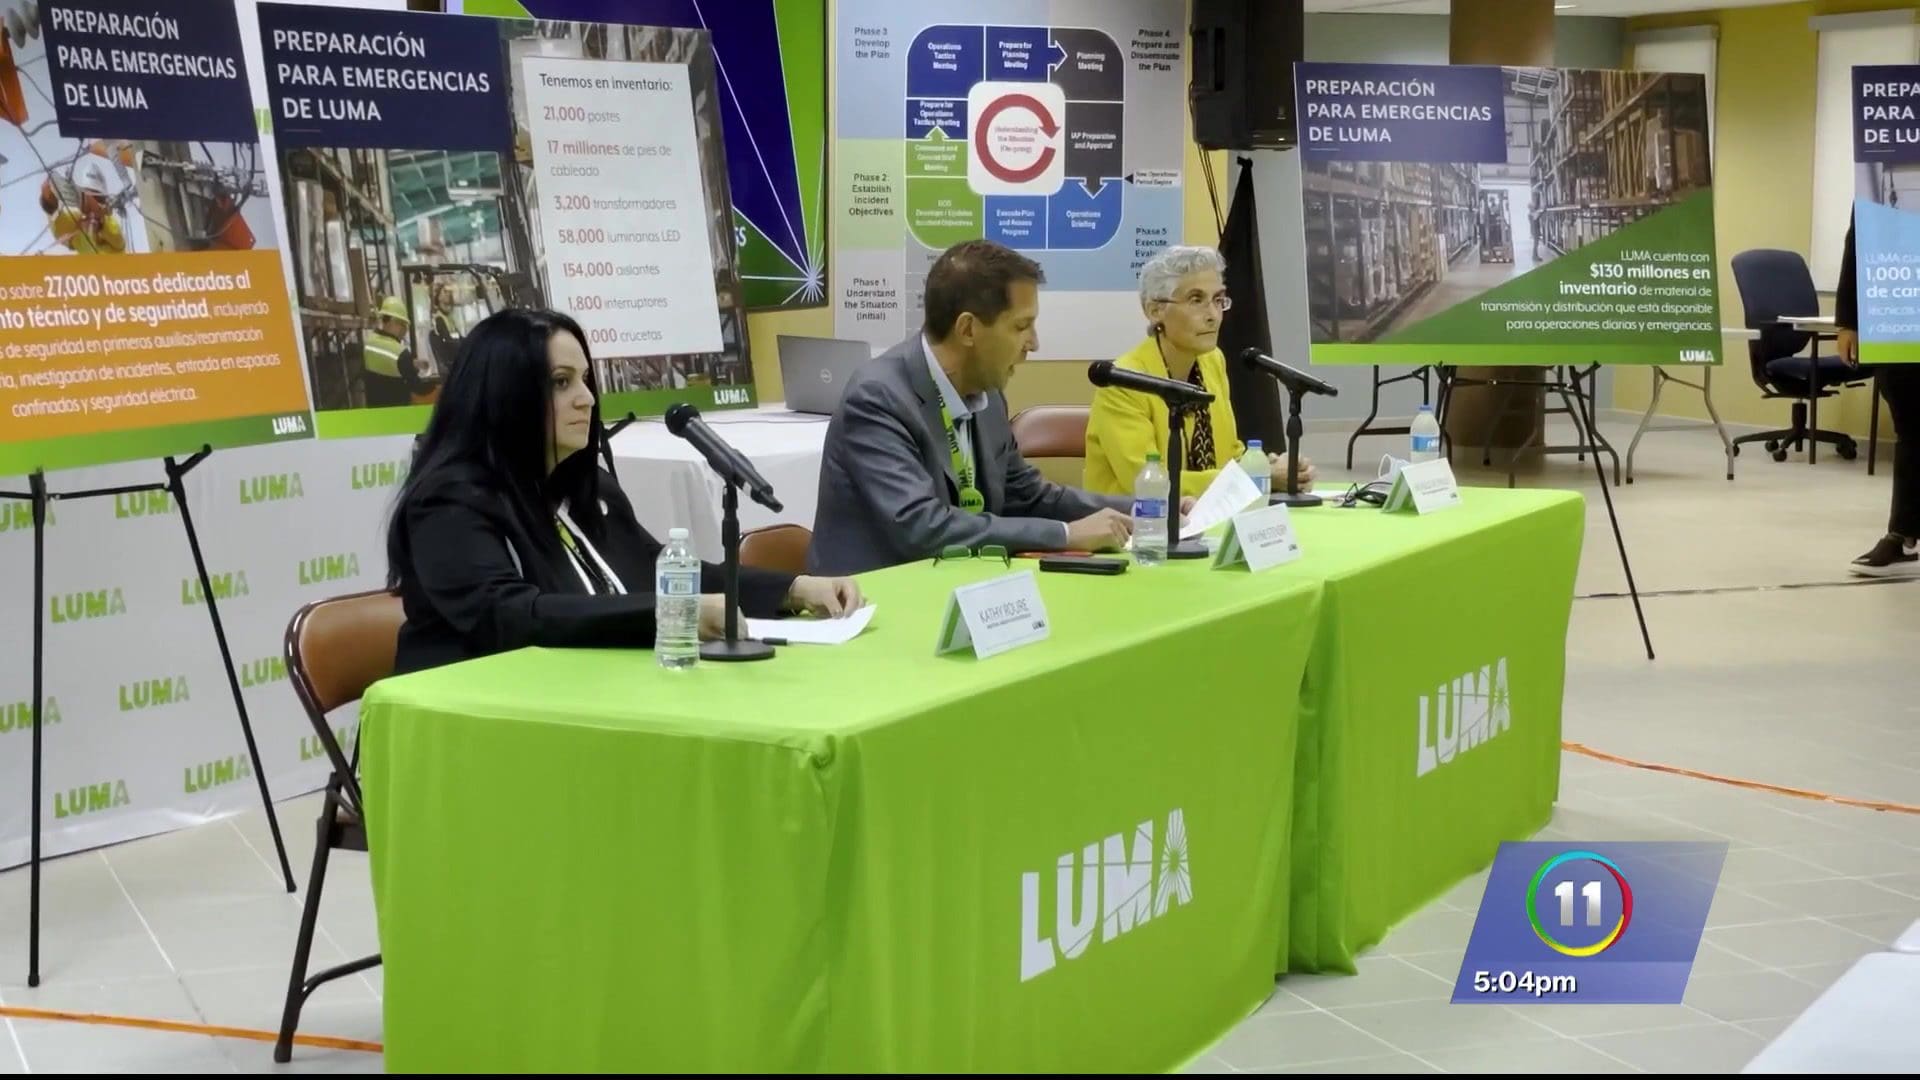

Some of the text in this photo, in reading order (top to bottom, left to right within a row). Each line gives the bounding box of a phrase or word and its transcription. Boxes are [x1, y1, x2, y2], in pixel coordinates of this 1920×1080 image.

[51, 7, 180, 40] PREPARACIÓN
[854, 27, 880, 36] Phase
[1139, 29, 1162, 38] Phase
[273, 29, 426, 58] PREPARACIÓN
[854, 38, 890, 48] Develop
[1132, 40, 1163, 49] Prepare
[57, 45, 237, 79] PARA EMERGENCIAS
[870, 51, 890, 59] Plan
[1139, 63, 1171, 71] the Plan
[277, 63, 490, 93] PARA EMERGENCIAS
[539, 73, 673, 91] Tenemos en inventario:
[1306, 78, 1435, 97] PREPARACIÓN
[63, 83, 149, 110] DE LUMA
[282, 98, 382, 121] DE LUMA
[543, 106, 621, 124] 21,000 postes
[1308, 104, 1492, 121] PARA EMERGENCIAS
[1864, 105, 1915, 120] PARA
[1309, 126, 1391, 142] DE LUMA
[1864, 128, 1920, 143] DE LU
[547, 140, 558, 154] 17
[622, 144, 635, 156] de
[637, 145, 657, 158] pies
[659, 144, 672, 157] de
[550, 164, 600, 177] cableado
[854, 174, 880, 182] Phase
[852, 184, 891, 193] Establish
[554, 195, 677, 212] 3,200 transformadores
[849, 208, 893, 217] Objectives
[558, 228, 604, 246] 58,000
[662, 229, 680, 242] LED
[1136, 227, 1160, 235] Phase
[1621, 250, 1709, 262] LUMA cuenta con
[563, 262, 660, 279] 154,000 aislantes
[1590, 262, 1710, 279] $130 millones en
[1866, 267, 1911, 282] 1,000
[9, 269, 251, 300] sobre 27,000 horas dedicadas al
[847, 289, 895, 297] Understand
[1560, 280, 1712, 297] inventario de material de
[1866, 286, 1888, 298] de
[567, 295, 668, 313] 1,800 interruptores
[1481, 301, 1713, 315] transmisión y distribución que está disponible
[27, 304, 89, 327] técnico
[91, 308, 101, 331] y
[105, 302, 126, 323] de
[129, 298, 212, 327] seguridad,
[213, 301, 269, 318] incluyendo
[856, 312, 886, 320] (Initial)
[1506, 318, 1713, 333] para operaciones diarias y emergencias.
[620, 329, 663, 341] crucetas
[6, 342, 22, 358] de
[24, 337, 84, 361] seguridad
[86, 339, 100, 352] en
[103, 336, 153, 356] primeros
[1680, 350, 1714, 362] LUMA
[20, 353, 281, 389] investigación de incidentes, entrada en espacios
[12, 397, 80, 418] confinados
[80, 399, 88, 415] y
[90, 391, 148, 414] seguridad
[714, 388, 749, 405] LUMA
[272, 415, 306, 435] LUMA
[240, 473, 303, 504] LUMA
[115, 491, 176, 519] LUM
[300, 553, 360, 585] LUMA
[51, 588, 126, 623] LUMA
[979, 606, 1003, 624] KATHY
[119, 675, 190, 711] LUMA
[1416, 657, 1510, 778] LUMA
[184, 754, 252, 793] LUMA
[54, 780, 130, 818] LUMA
[1020, 807, 1193, 982] LUMA
